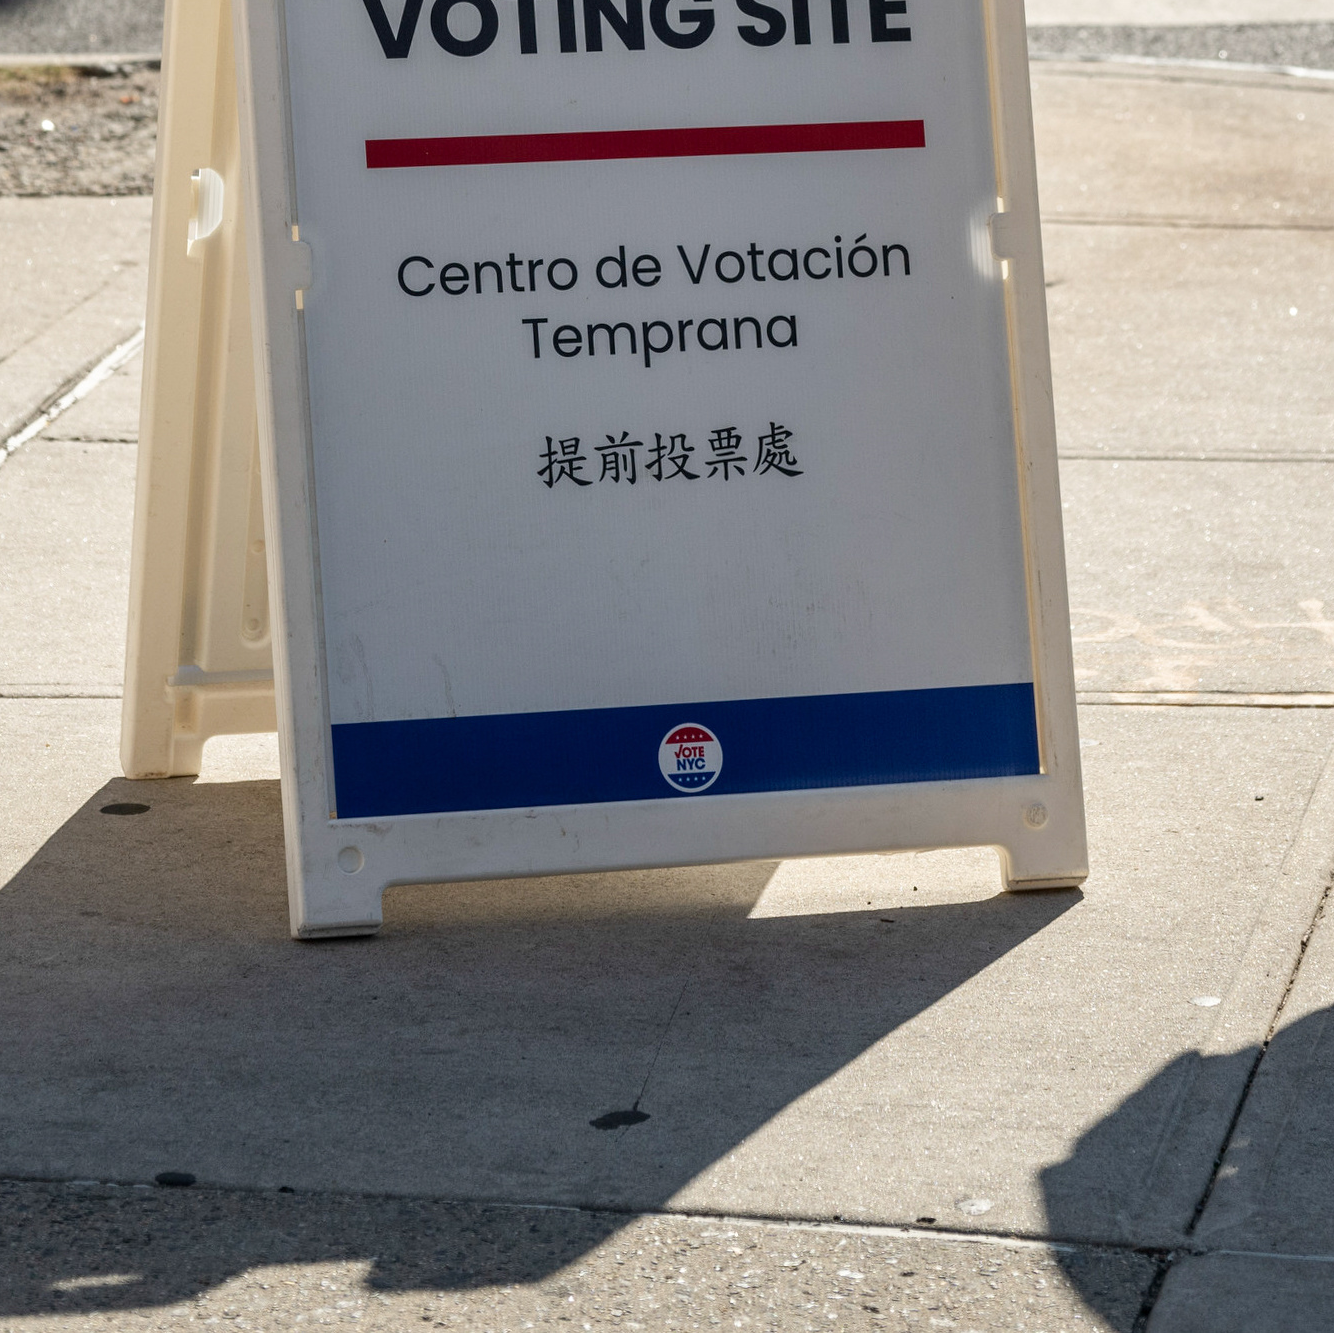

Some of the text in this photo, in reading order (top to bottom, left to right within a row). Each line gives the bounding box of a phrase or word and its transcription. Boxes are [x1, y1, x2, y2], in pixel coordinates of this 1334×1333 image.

[396, 233, 912, 298] Centro de Votación
[522, 313, 799, 369] Temprana
[536, 421, 805, 489] 提前投票處
[677, 758, 706, 771] NYC
